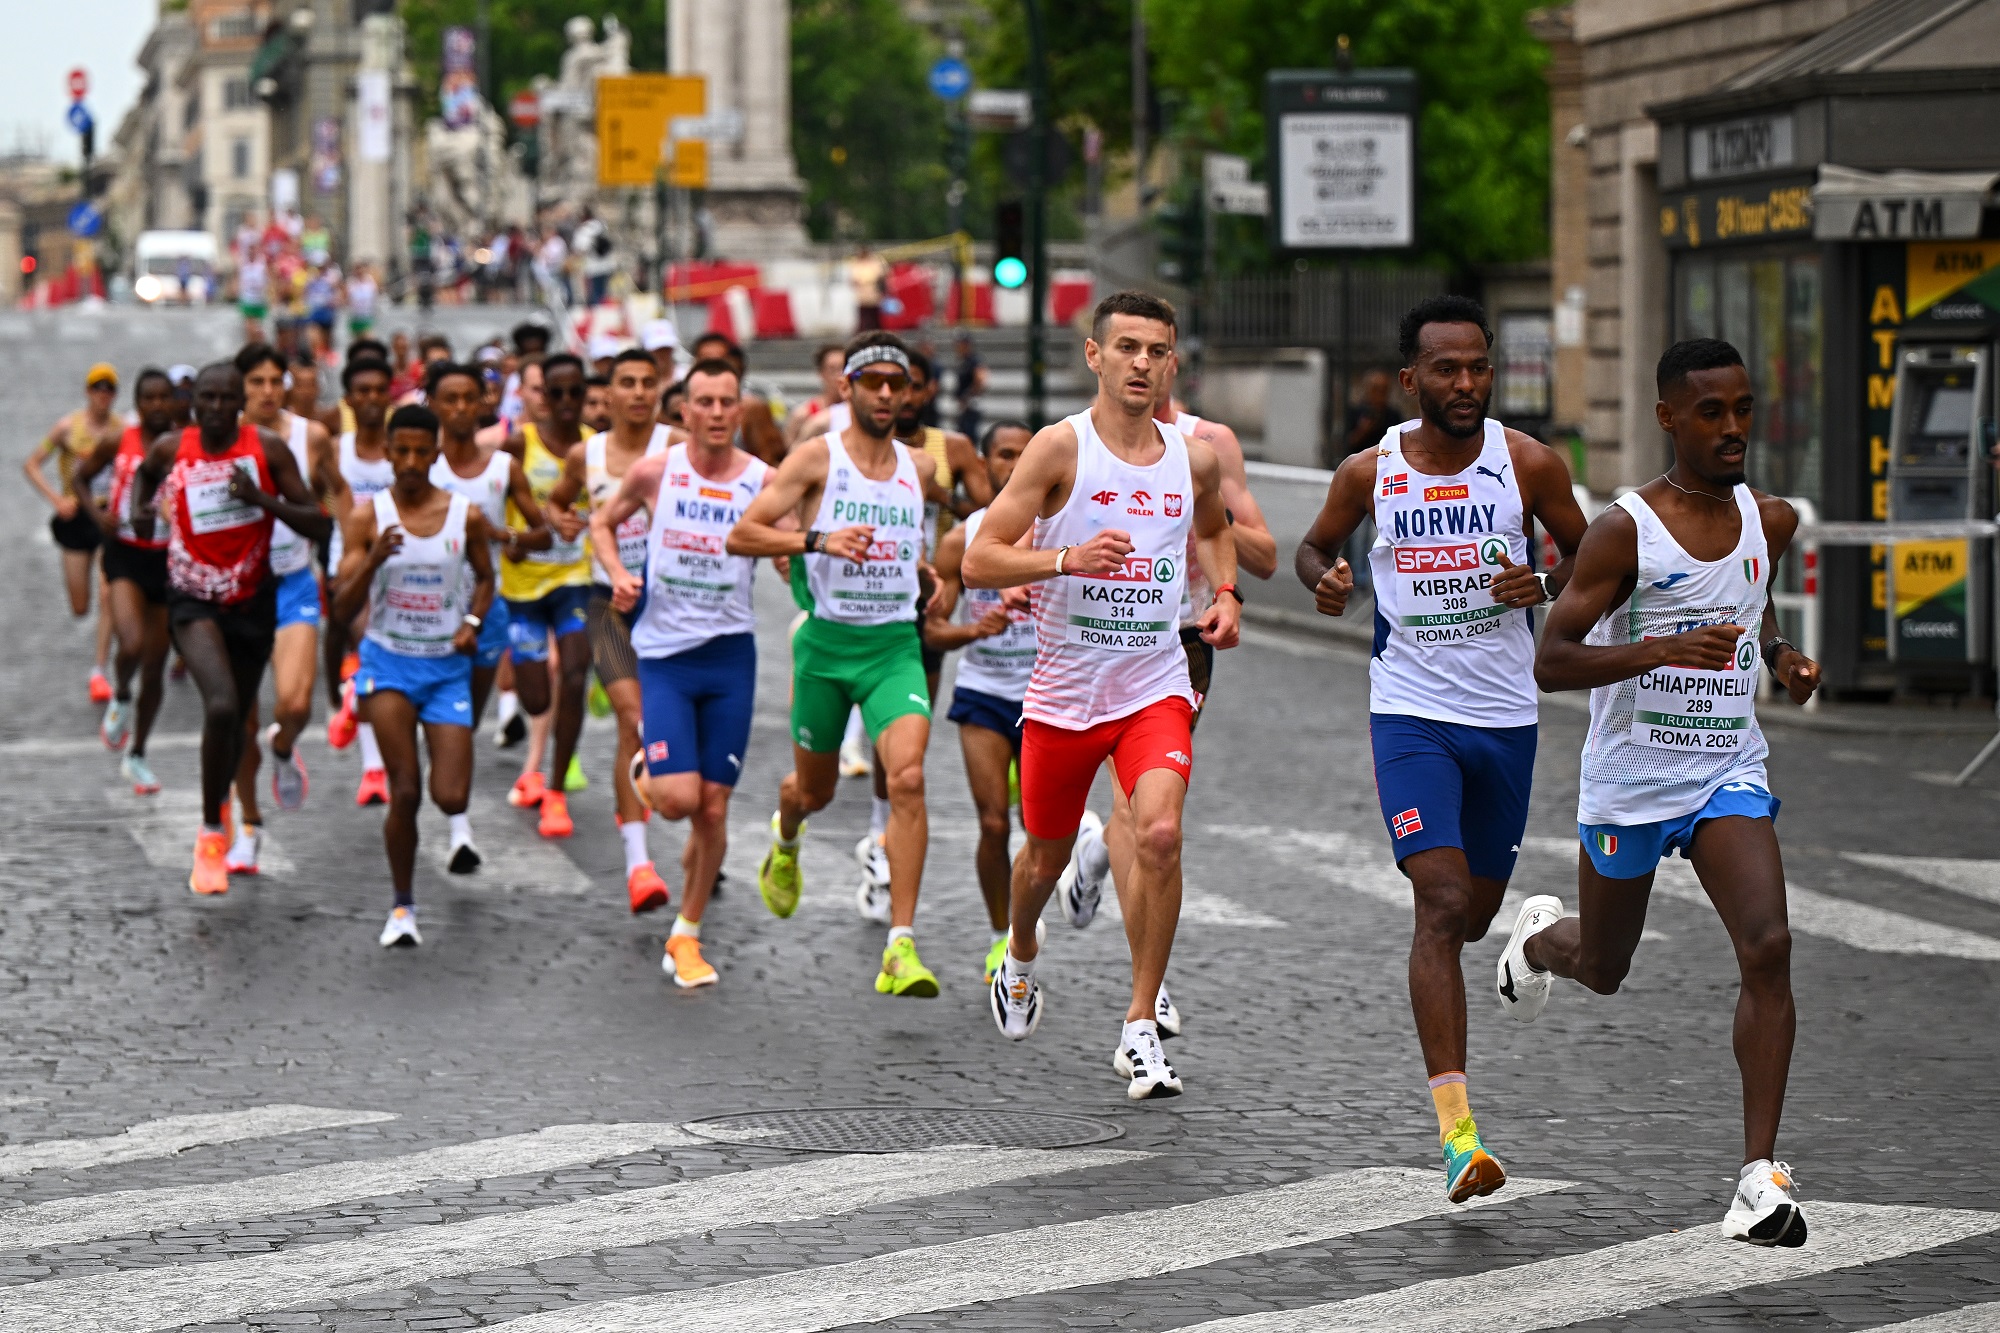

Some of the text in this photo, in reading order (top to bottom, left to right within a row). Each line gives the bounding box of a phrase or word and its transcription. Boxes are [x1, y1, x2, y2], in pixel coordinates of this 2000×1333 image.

[1853, 199, 1943, 238] ATM
[1935, 251, 1983, 273] ATM
[1091, 490, 1118, 505] 4F
[1439, 489, 1466, 497] EXTRA
[833, 500, 915, 528] PORTUGAL
[1127, 508, 1154, 516] ORLEN
[1394, 504, 1495, 538] NORWAY
[678, 555, 723, 569] MOEN
[1397, 547, 1477, 570] SPAR
[1904, 552, 1953, 573] ATM
[843, 564, 903, 577] BARATA
[1413, 573, 1492, 597] KIBRAB
[1082, 585, 1163, 604] KACZOR
[840, 602, 873, 612] ROMA
[1442, 597, 1468, 610] 308
[1686, 605, 1737, 614] FRECCIAROSSA
[1111, 606, 1134, 618] 314
[1094, 619, 1117, 629] RUN
[1118, 622, 1150, 631] CLEAN
[1427, 615, 1451, 625] RUN
[1416, 619, 1501, 642] ROMA 2024
[1081, 631, 1157, 647] ROMA 2024
[1639, 672, 1750, 696] CHIAPPINELLI
[1686, 700, 1713, 713] 289
[1667, 716, 1694, 726] RUN
[1650, 729, 1738, 748] ROMA 2024
